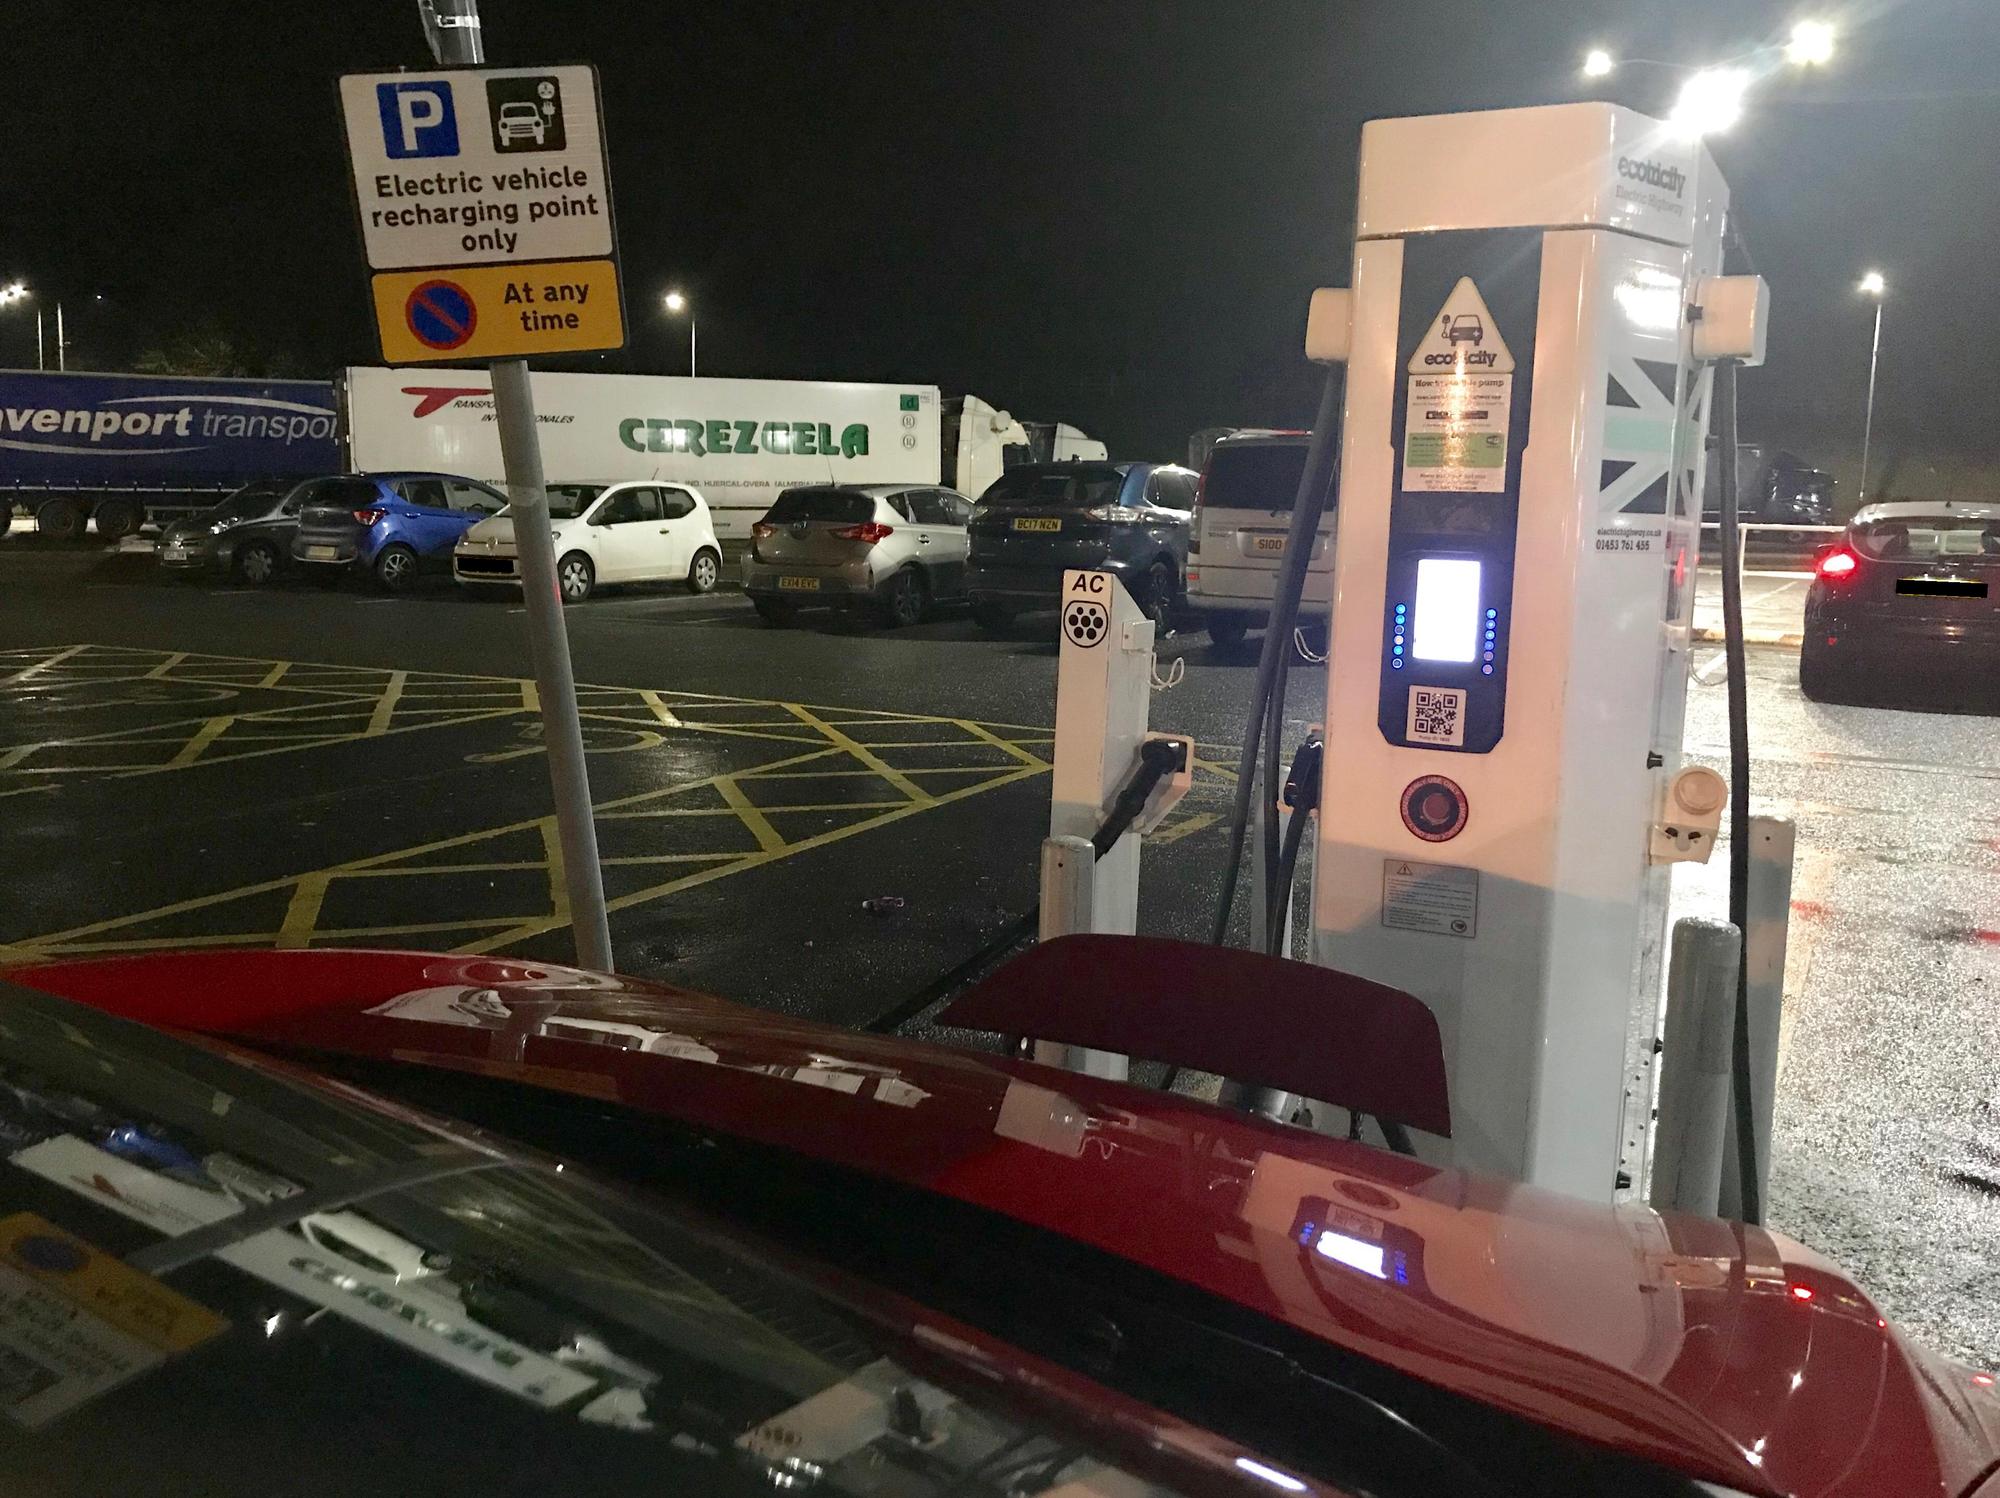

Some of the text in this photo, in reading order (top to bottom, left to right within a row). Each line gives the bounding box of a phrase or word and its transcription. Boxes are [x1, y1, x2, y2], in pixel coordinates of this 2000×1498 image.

[397, 90, 444, 151] P
[375, 165, 588, 199] Electric vehicle
[371, 194, 599, 228] recharging point
[461, 228, 518, 253] only
[504, 282, 590, 306] At any
[520, 310, 580, 332] time
[1424, 350, 1498, 368] ecoticity
[0, 406, 193, 442] venport
[1596, 539, 1650, 551] 01453 761 455
[1072, 573, 1105, 593] AC
